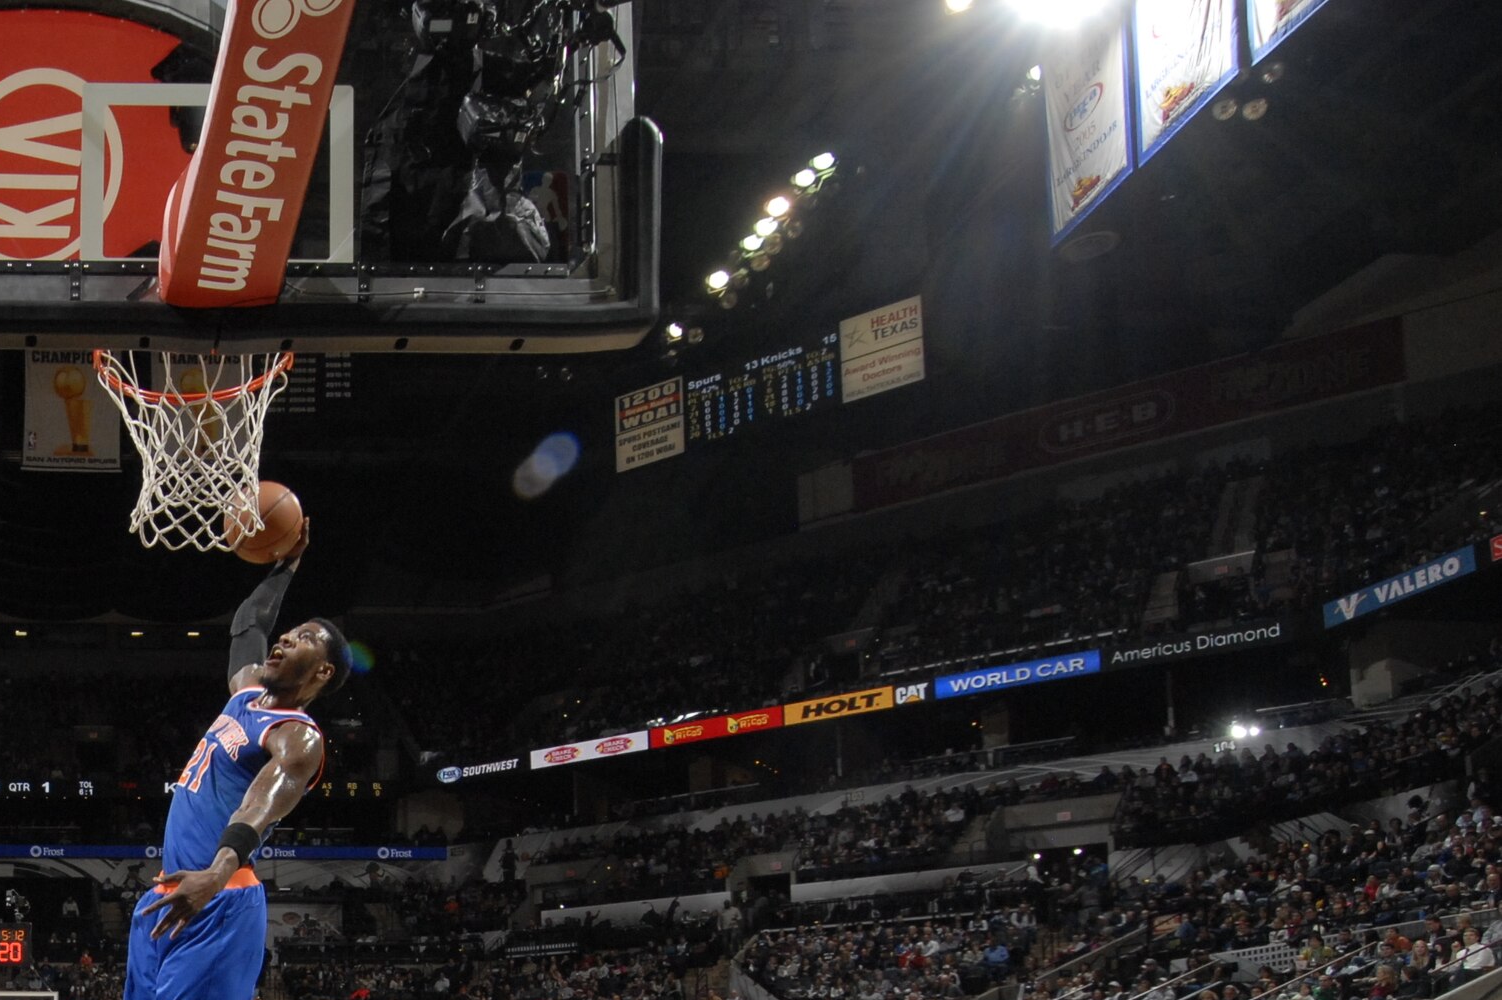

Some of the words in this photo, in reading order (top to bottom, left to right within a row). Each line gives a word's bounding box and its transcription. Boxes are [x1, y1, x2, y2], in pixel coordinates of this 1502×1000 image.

[871, 305, 917, 329] HEALTH
[872, 317, 918, 341] TEXAS
[760, 346, 803, 366] Knicks
[822, 333, 838, 345] 15
[844, 360, 875, 376] Award
[879, 347, 921, 364] Winning
[862, 364, 902, 382] Doctors
[688, 373, 722, 390] Spurs
[744, 360, 759, 371] 13
[622, 382, 676, 408] 1200
[1374, 557, 1460, 603] VALERO
[1112, 638, 1192, 665] Americus
[1196, 623, 1281, 650] Diamond
[950, 668, 1032, 692] WORLD
[1035, 657, 1085, 679] CAR
[801, 692, 882, 718] HOLT
[895, 683, 928, 704] CAT
[552, 748, 572, 756] BRAKE
[603, 739, 625, 747] BRAKE
[178, 738, 218, 793] 21
[443, 770, 457, 780] FOX
[462, 758, 519, 777] SOUTHWEST
[8, 782, 31, 792] QTR
[41, 781, 50, 793] 1
[79, 781, 94, 789] TOL
[43, 847, 64, 856] Frost
[274, 848, 296, 858] Frost
[390, 848, 412, 859] Frost
[1, 930, 24, 941] 5:12
